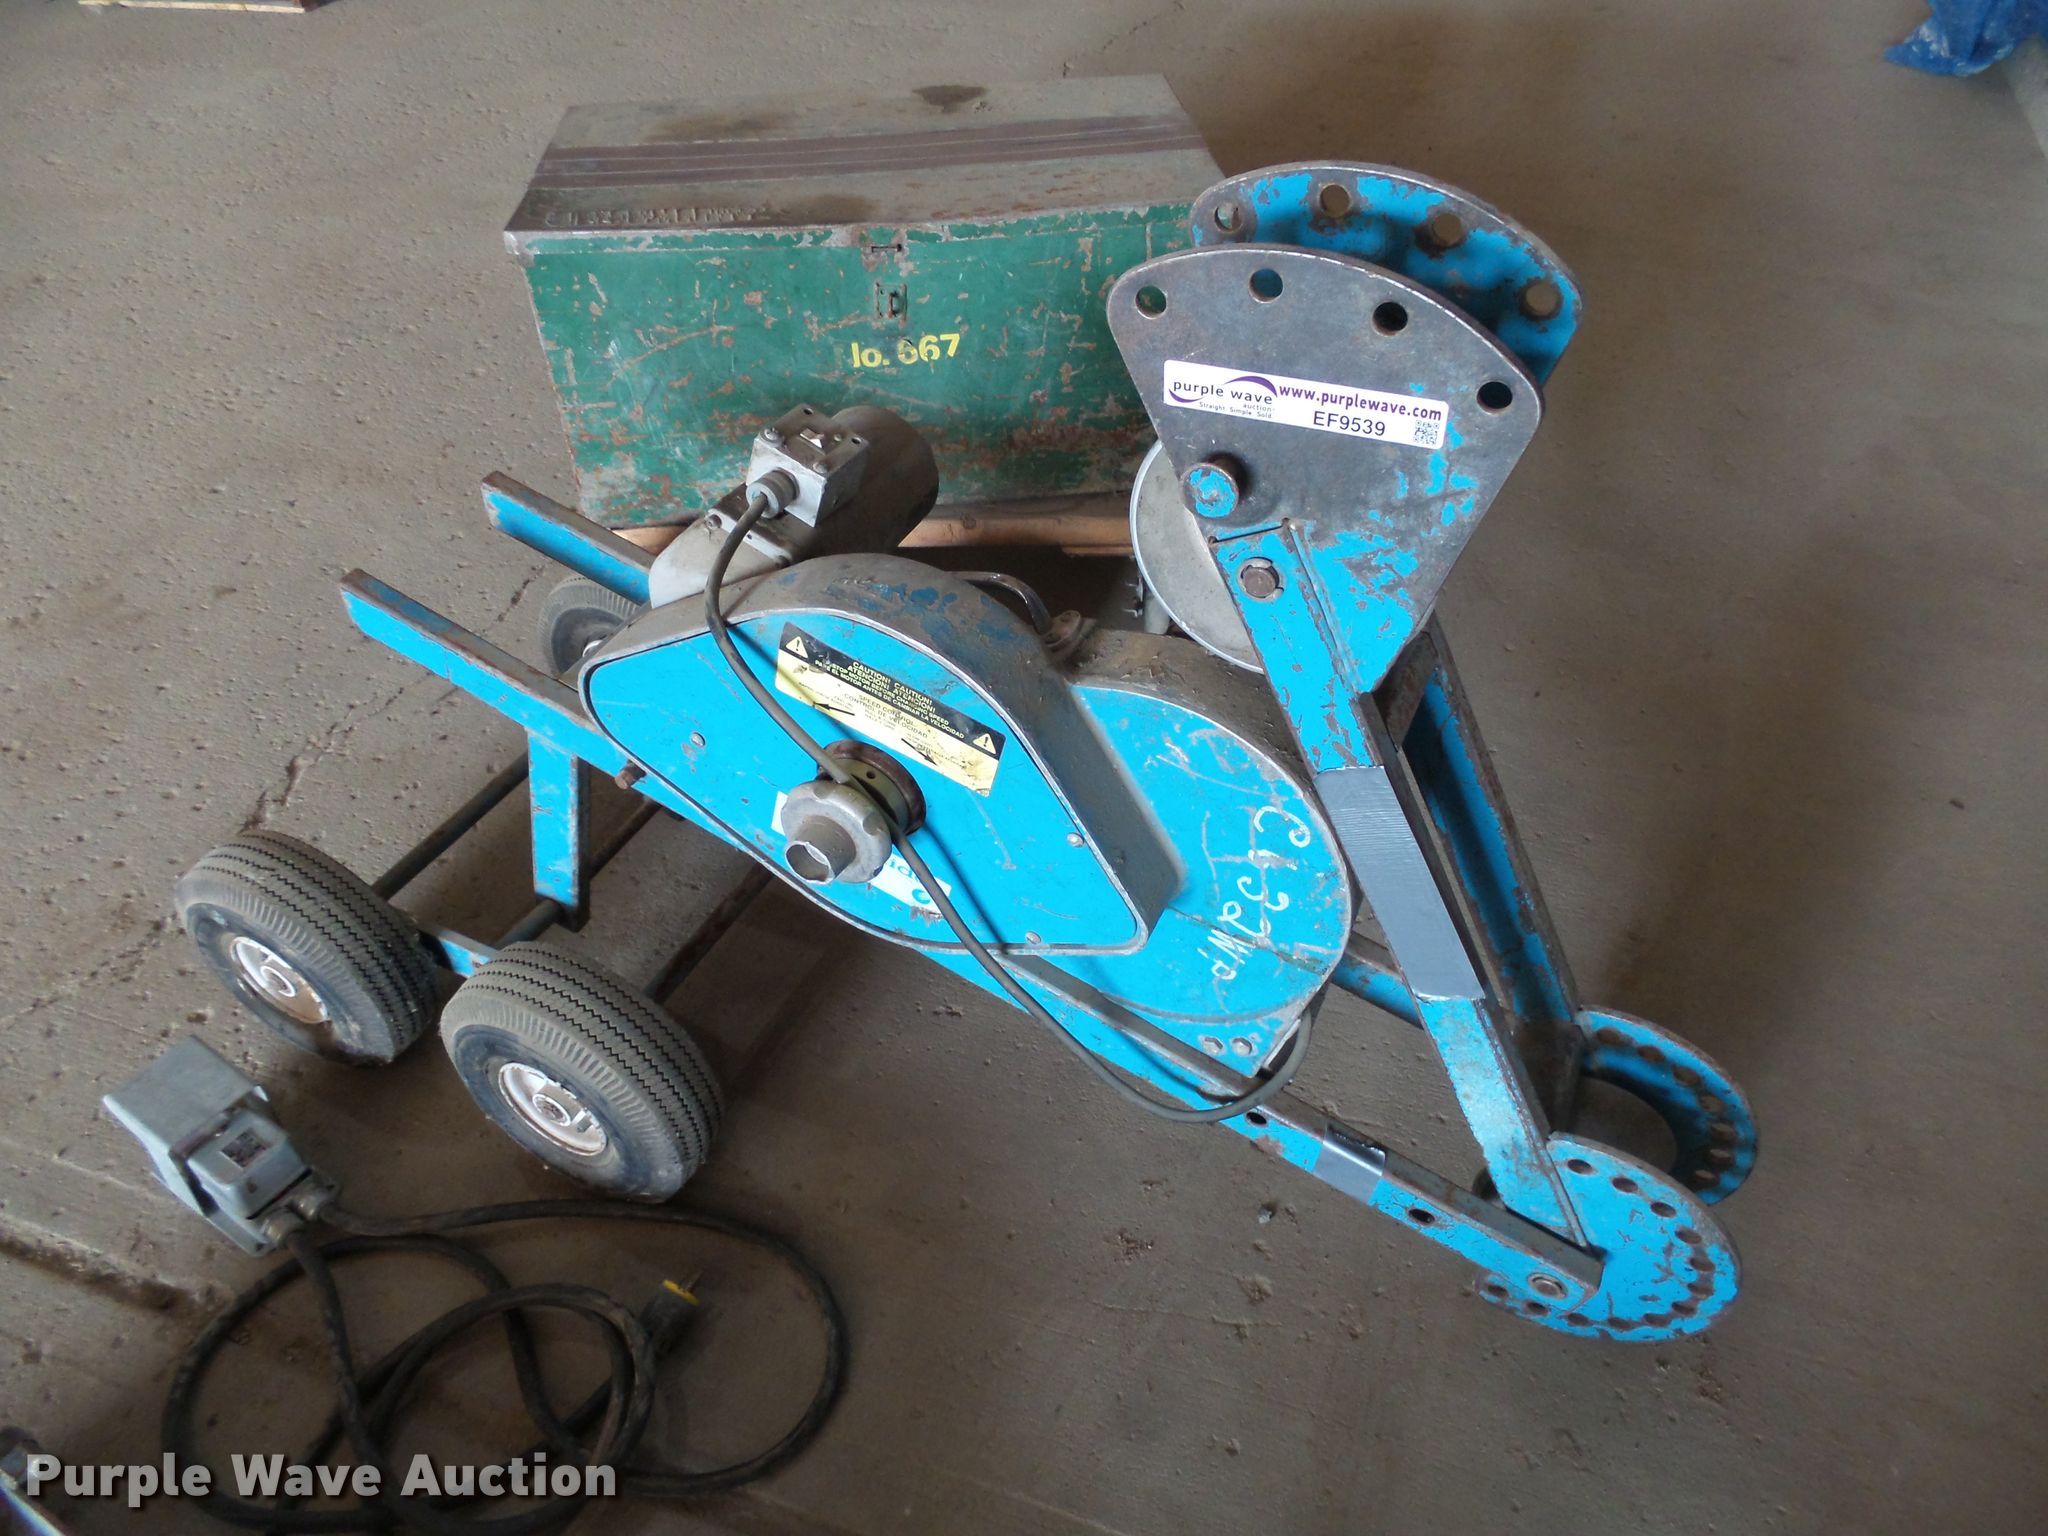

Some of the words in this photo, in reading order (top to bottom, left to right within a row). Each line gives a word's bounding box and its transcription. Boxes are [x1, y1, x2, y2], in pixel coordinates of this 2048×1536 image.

[897, 333, 960, 365] 667
[1173, 381, 1224, 397] purple
[1230, 390, 1273, 405] wave
[1279, 385, 1442, 421] www.purplewave.com
[1313, 410, 1386, 437] EF9539
[814, 659, 831, 671] PAE
[839, 672, 862, 687] MOTOR
[862, 683, 882, 697] ANTES
[892, 699, 920, 716] CAMBIAR
[929, 717, 965, 739] VELOCIDAD
[847, 671, 870, 686] MOTOR
[928, 711, 949, 726] SPEED
[852, 660, 891, 684] CAUTION!
[893, 682, 932, 705] CAUTION!
